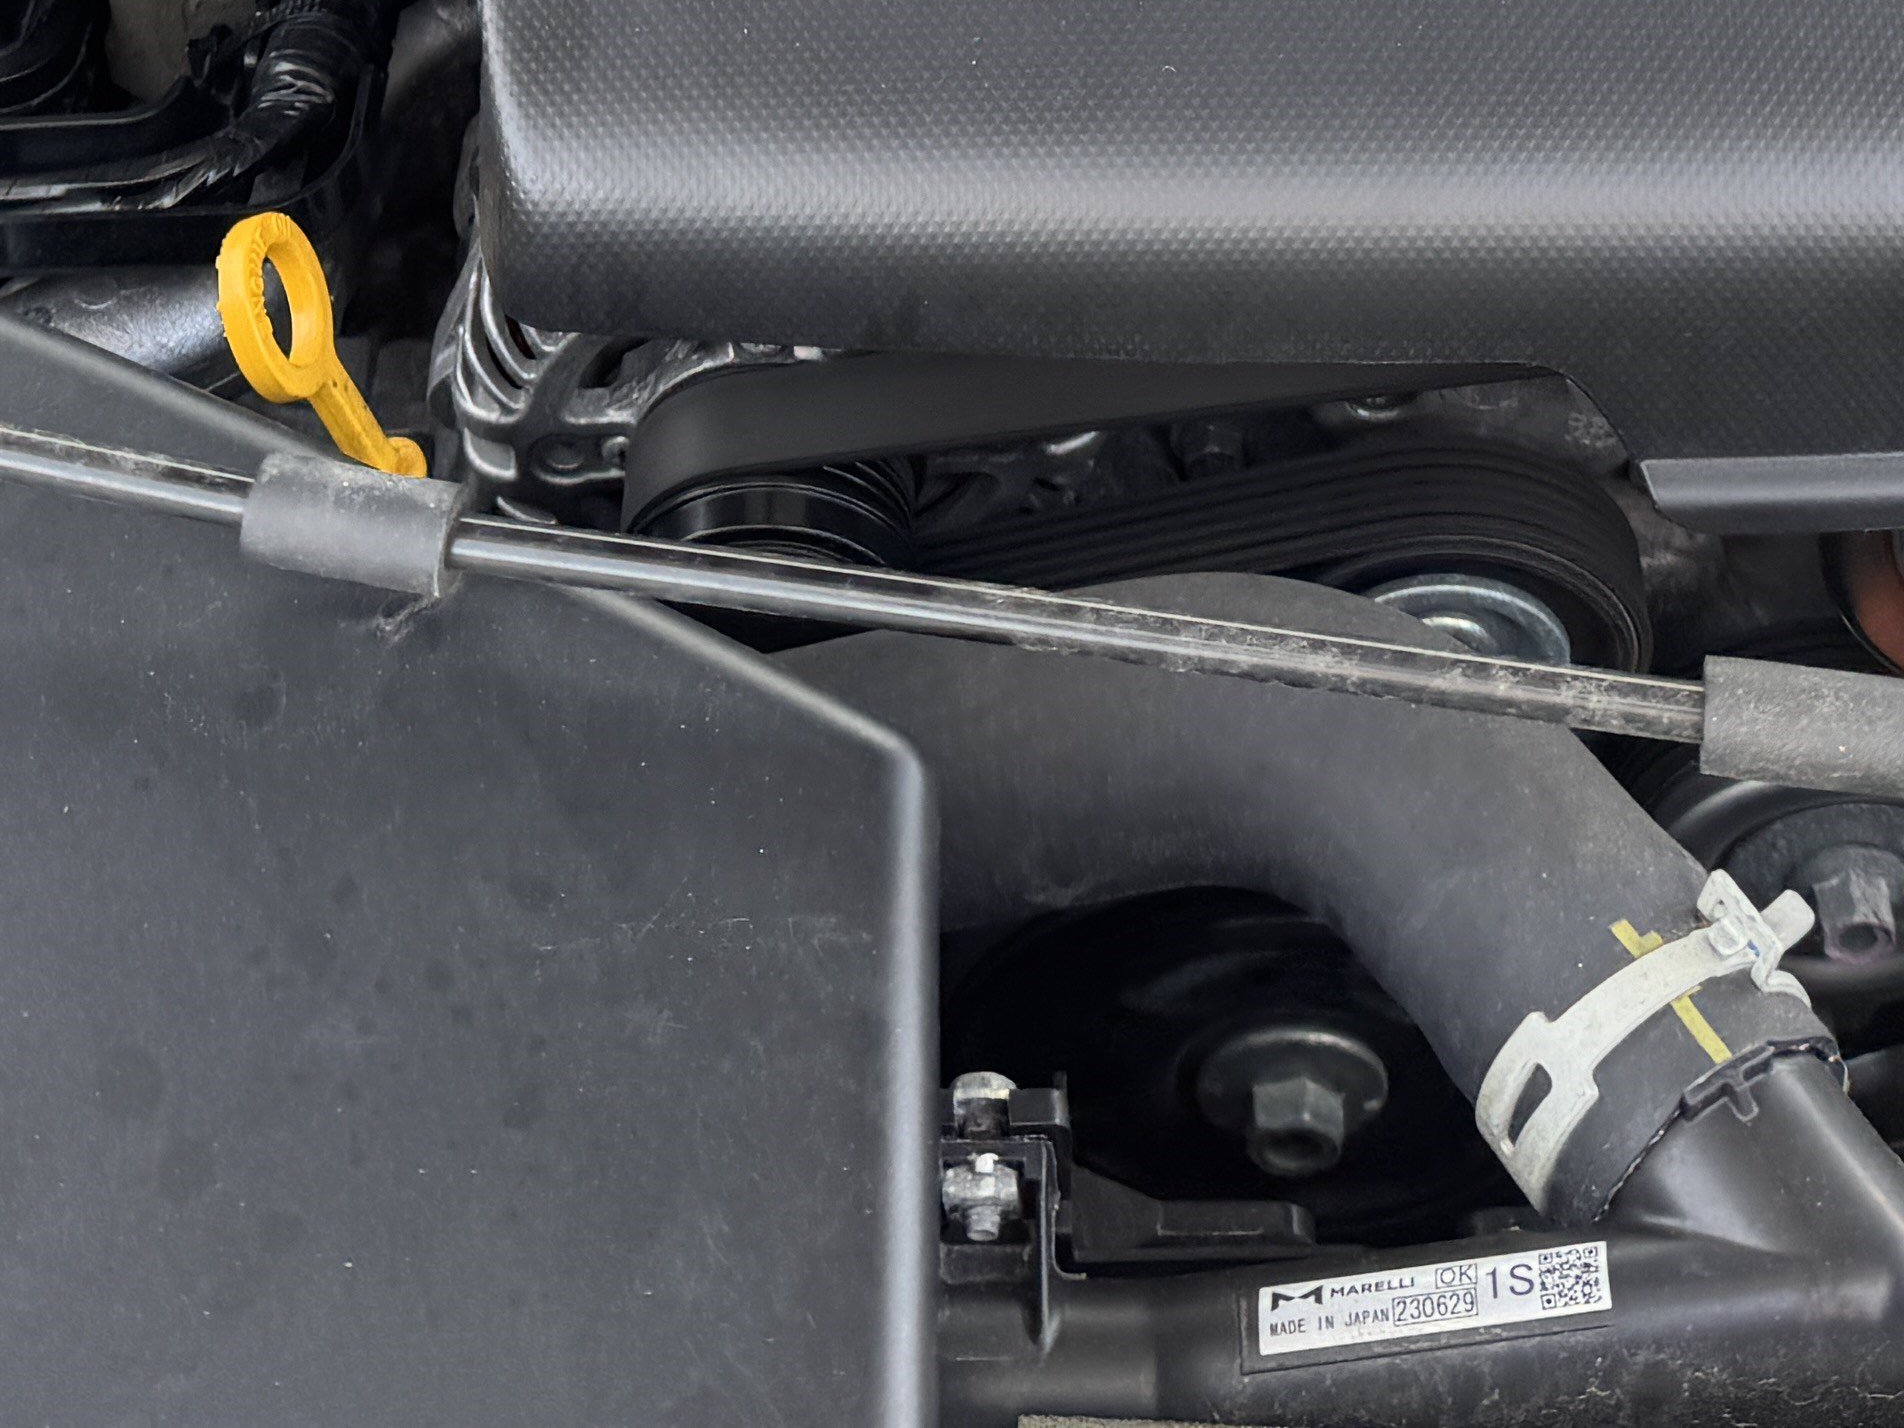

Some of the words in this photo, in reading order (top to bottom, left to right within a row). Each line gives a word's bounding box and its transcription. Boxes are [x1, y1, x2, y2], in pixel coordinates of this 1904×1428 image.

[1330, 1276, 1416, 1299] MARELLI
[1439, 1263, 1476, 1285] OK
[1484, 1262, 1536, 1300] 1S
[1269, 1320, 1307, 1337] MADE
[1317, 1315, 1336, 1331] IN
[1344, 1306, 1391, 1328] JAPAN
[1394, 1291, 1476, 1323] 230629
